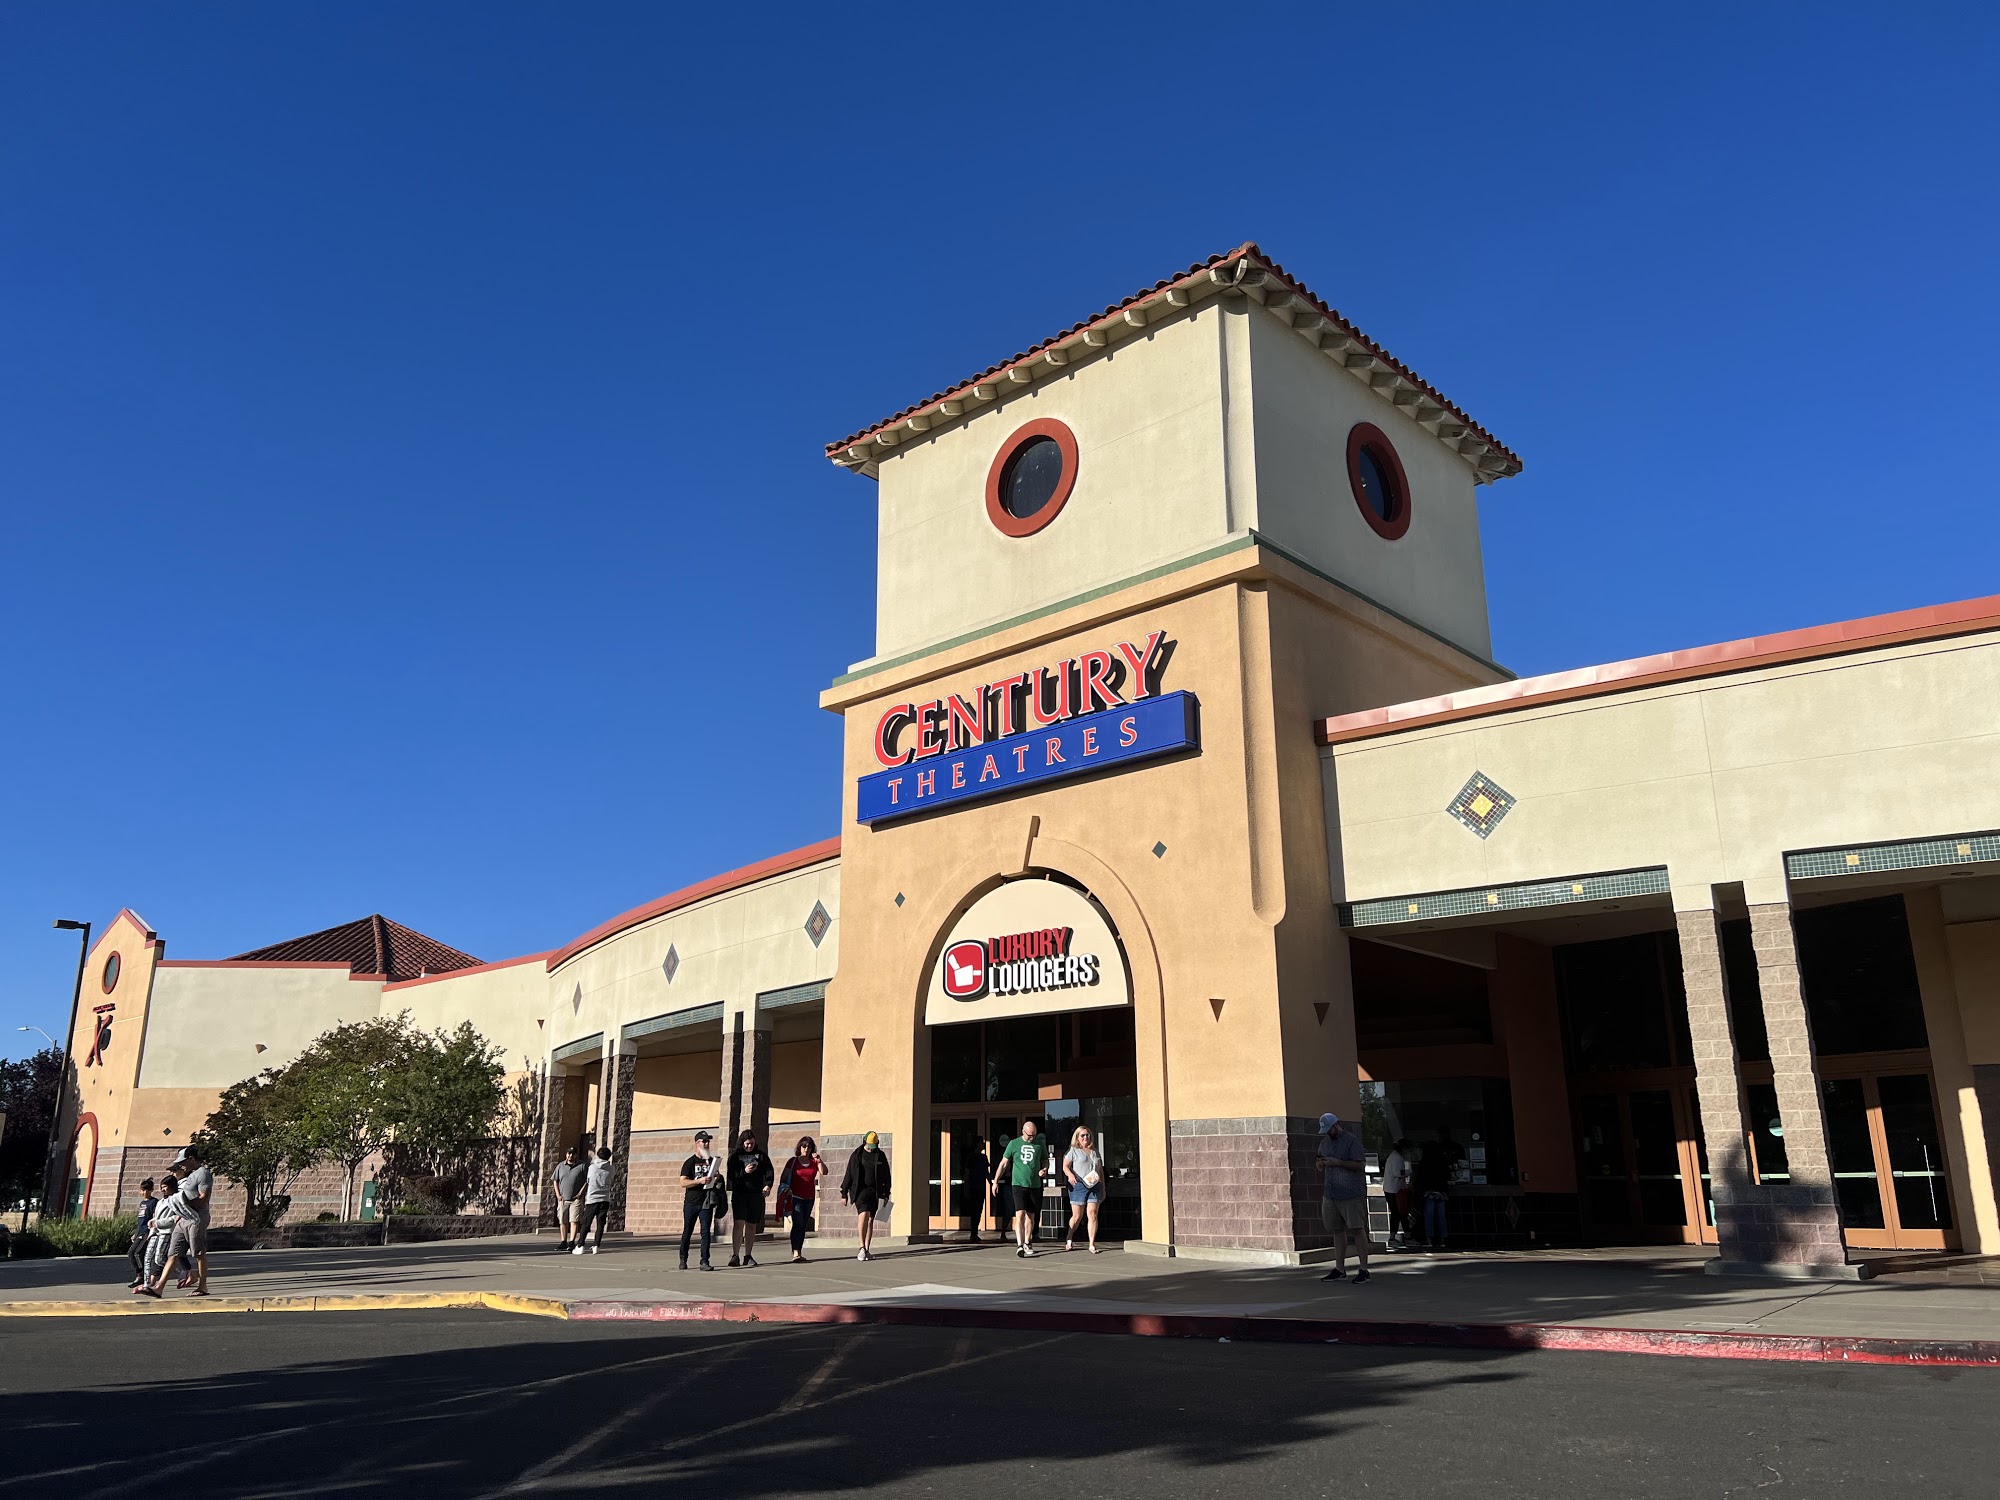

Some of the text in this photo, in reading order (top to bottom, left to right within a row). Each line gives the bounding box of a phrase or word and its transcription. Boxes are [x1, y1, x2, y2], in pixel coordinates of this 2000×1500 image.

[873, 630, 1168, 769] CENTURY
[887, 716, 1139, 805] THEATRES
[988, 926, 1071, 964] LUXURY
[988, 953, 1094, 994] LOUNGERS
[1020, 1144, 1036, 1165] SF
[659, 1307, 679, 1317] FIRE
[681, 1307, 703, 1317] LANE
